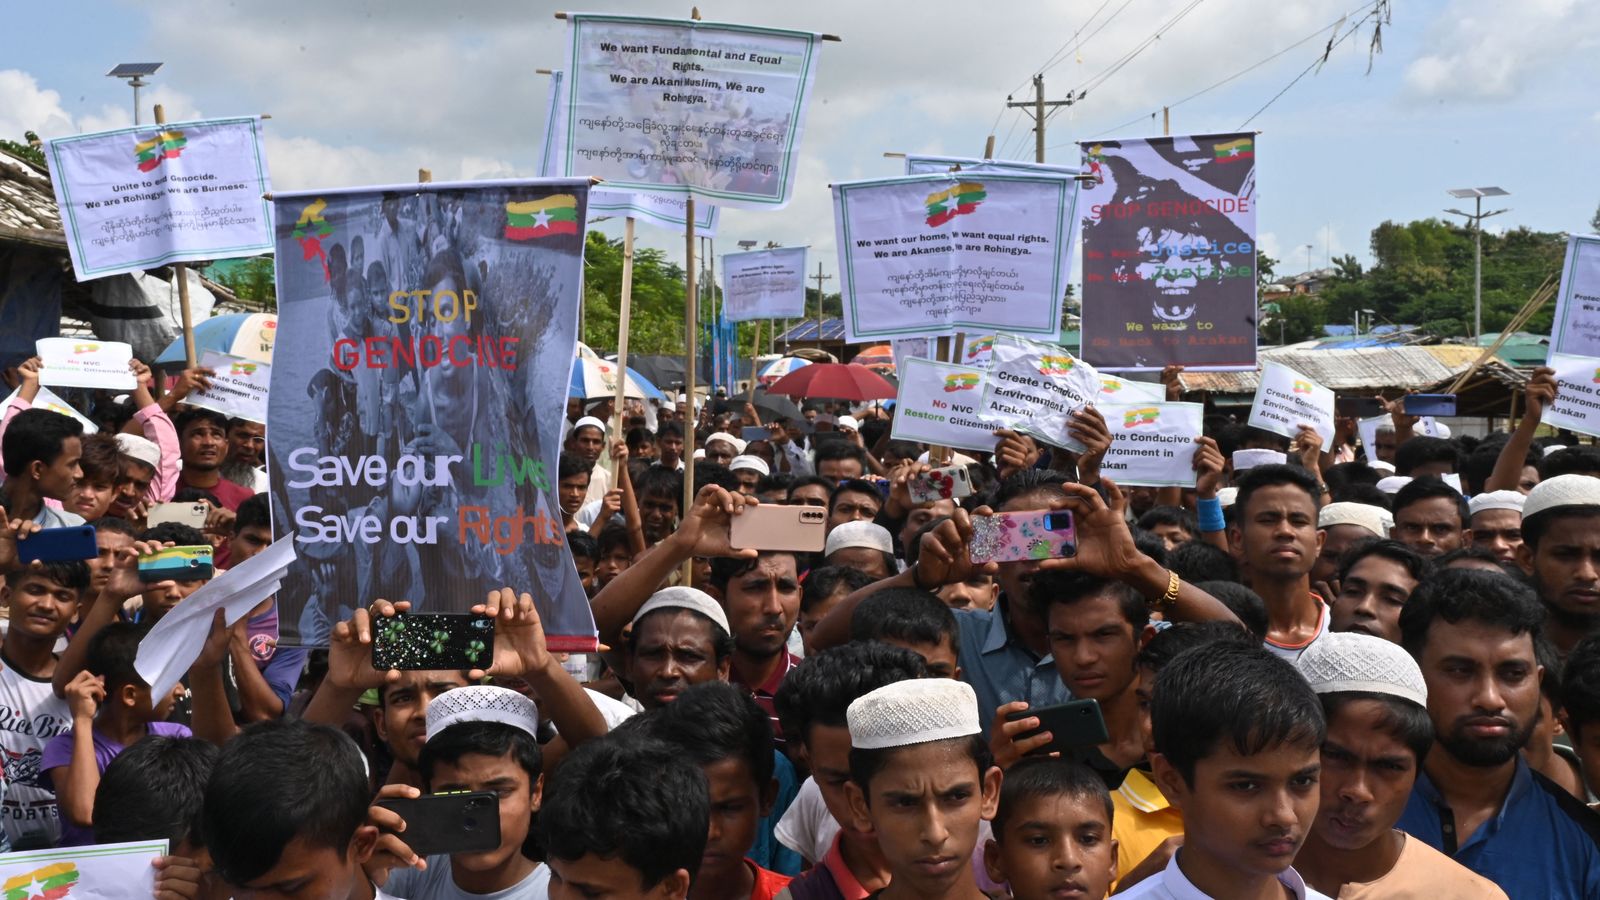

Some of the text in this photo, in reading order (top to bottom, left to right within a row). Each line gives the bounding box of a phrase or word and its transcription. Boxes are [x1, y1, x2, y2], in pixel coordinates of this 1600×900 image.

[600, 43, 782, 65] We want Fundamental and Equal
[672, 61, 704, 73] Rights.
[610, 74, 627, 83] We
[630, 77, 648, 85] are
[726, 81, 743, 91] We
[746, 85, 765, 93] are
[663, 92, 707, 104] Rohingya.
[112, 182, 139, 192] Unite
[155, 176, 168, 186] end
[170, 173, 218, 182] Genocide.
[85, 201, 101, 209] We
[104, 199, 120, 207] are
[202, 183, 248, 193] Burmese.
[1091, 197, 1249, 220] STOP GENOCIDE
[857, 240, 871, 248] We
[874, 237, 898, 246] want
[901, 235, 917, 243] our
[920, 232, 950, 242] home,
[961, 231, 985, 239] want
[987, 233, 1015, 241] equal
[1018, 233, 1049, 243] rights.
[911, 244, 954, 256] Akanese,
[984, 244, 1031, 255] Rohingya.
[1150, 240, 1252, 257] Justice
[1151, 263, 1251, 280] Justice
[388, 289, 478, 324] STOP
[1126, 320, 1213, 332] We want to
[333, 335, 520, 370] GENOCIDE
[998, 371, 1039, 387] Create
[1557, 379, 1593, 394] Create
[994, 386, 1064, 413] Environment
[1266, 388, 1294, 401] Create
[932, 399, 973, 414] No NVC
[990, 401, 1034, 418] Arakan
[1551, 404, 1586, 419] Arakan
[904, 408, 945, 422] Restore
[1260, 410, 1289, 423] Arakan
[1130, 433, 1190, 443] Conducive
[1163, 448, 1174, 458] in
[288, 441, 550, 493] Save our Lives
[1101, 462, 1128, 470] akan
[295, 505, 564, 556] Save our Rights
